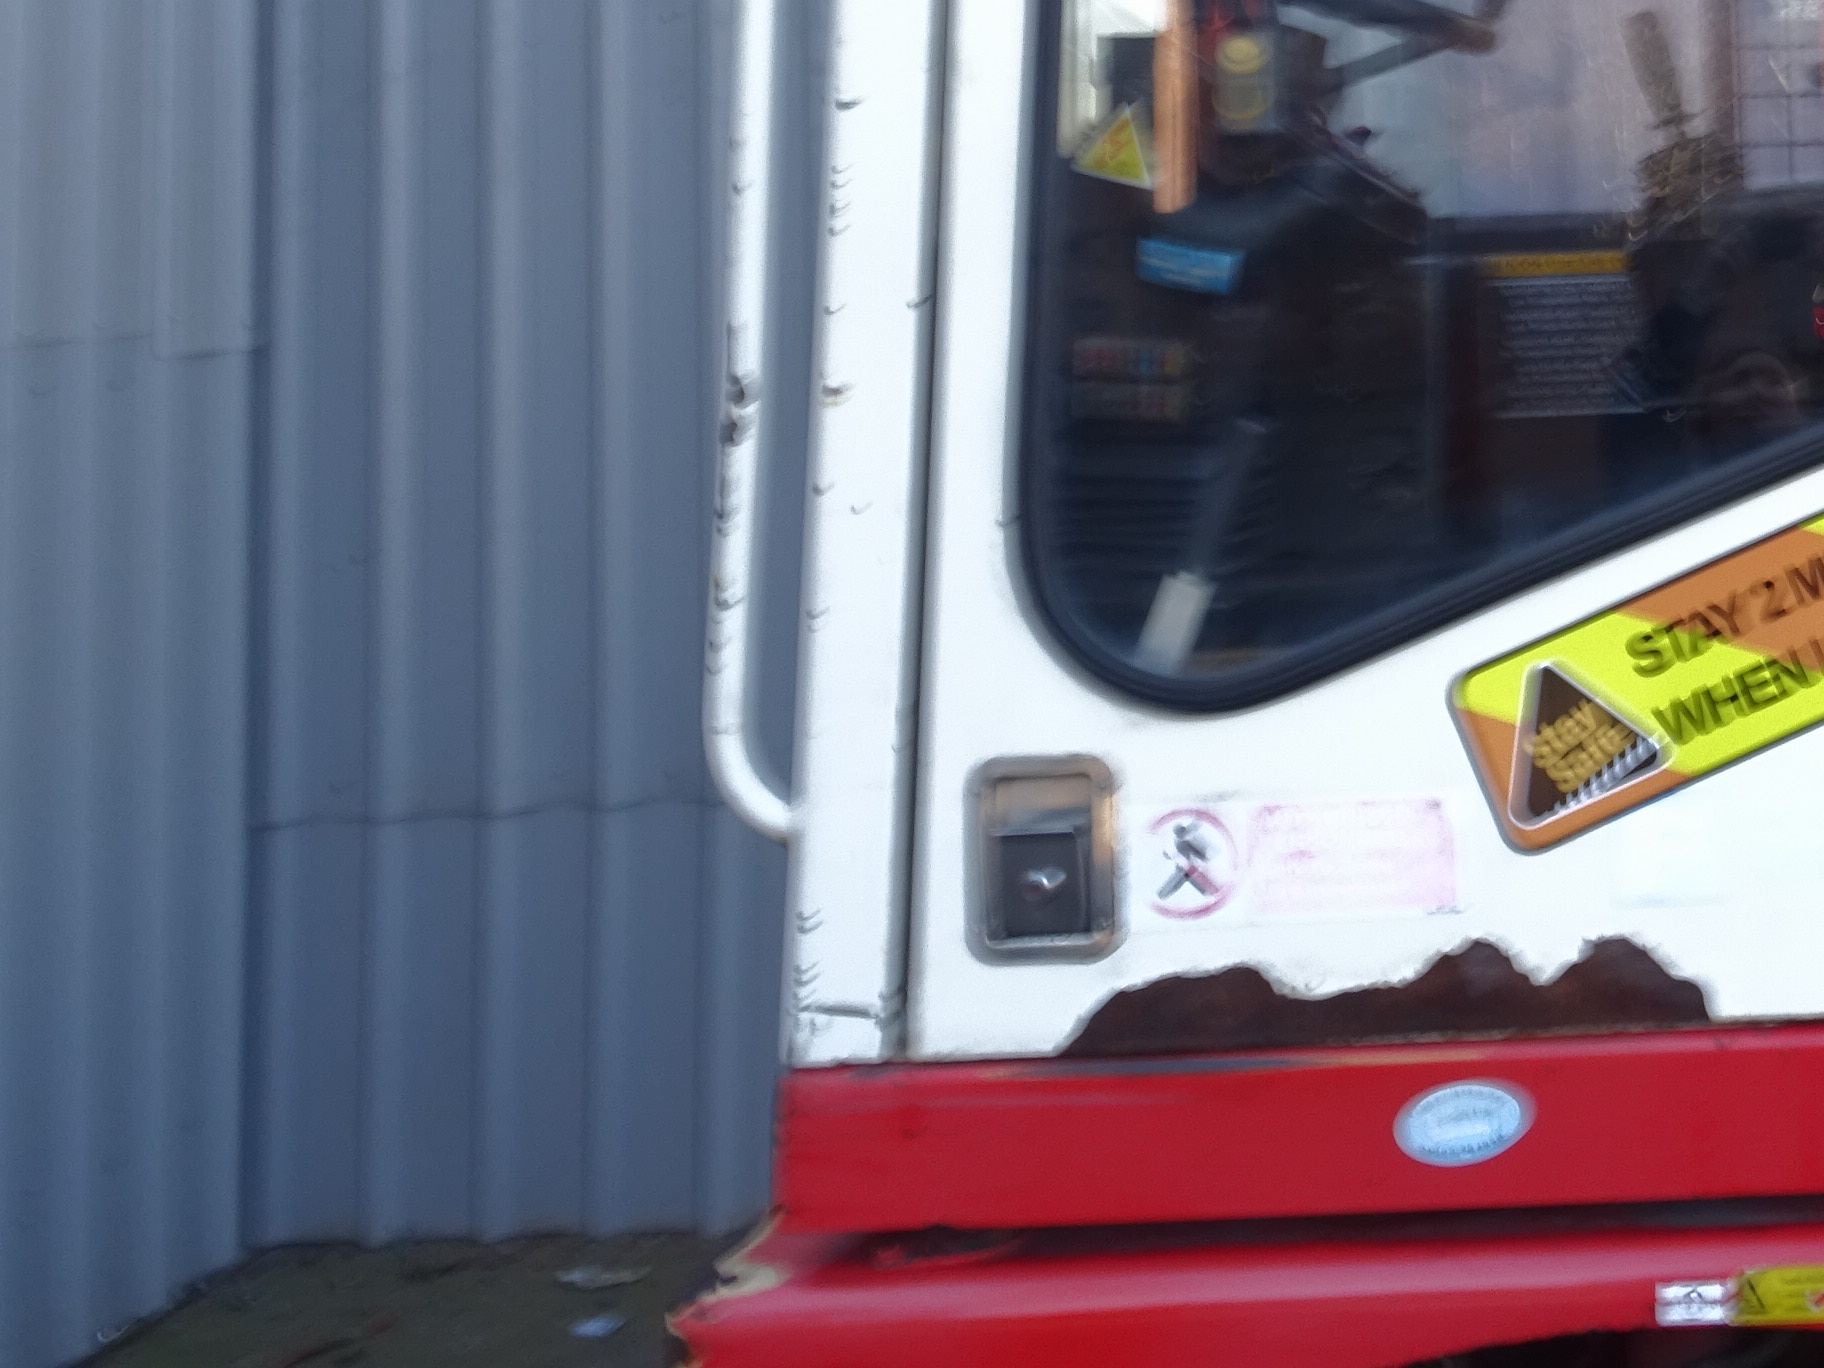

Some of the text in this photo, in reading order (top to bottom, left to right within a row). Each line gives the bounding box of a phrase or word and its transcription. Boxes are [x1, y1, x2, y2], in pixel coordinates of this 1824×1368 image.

[1624, 590, 1744, 679] STAY
[1756, 578, 1794, 622] 2
[1651, 646, 1819, 746] WHEN
